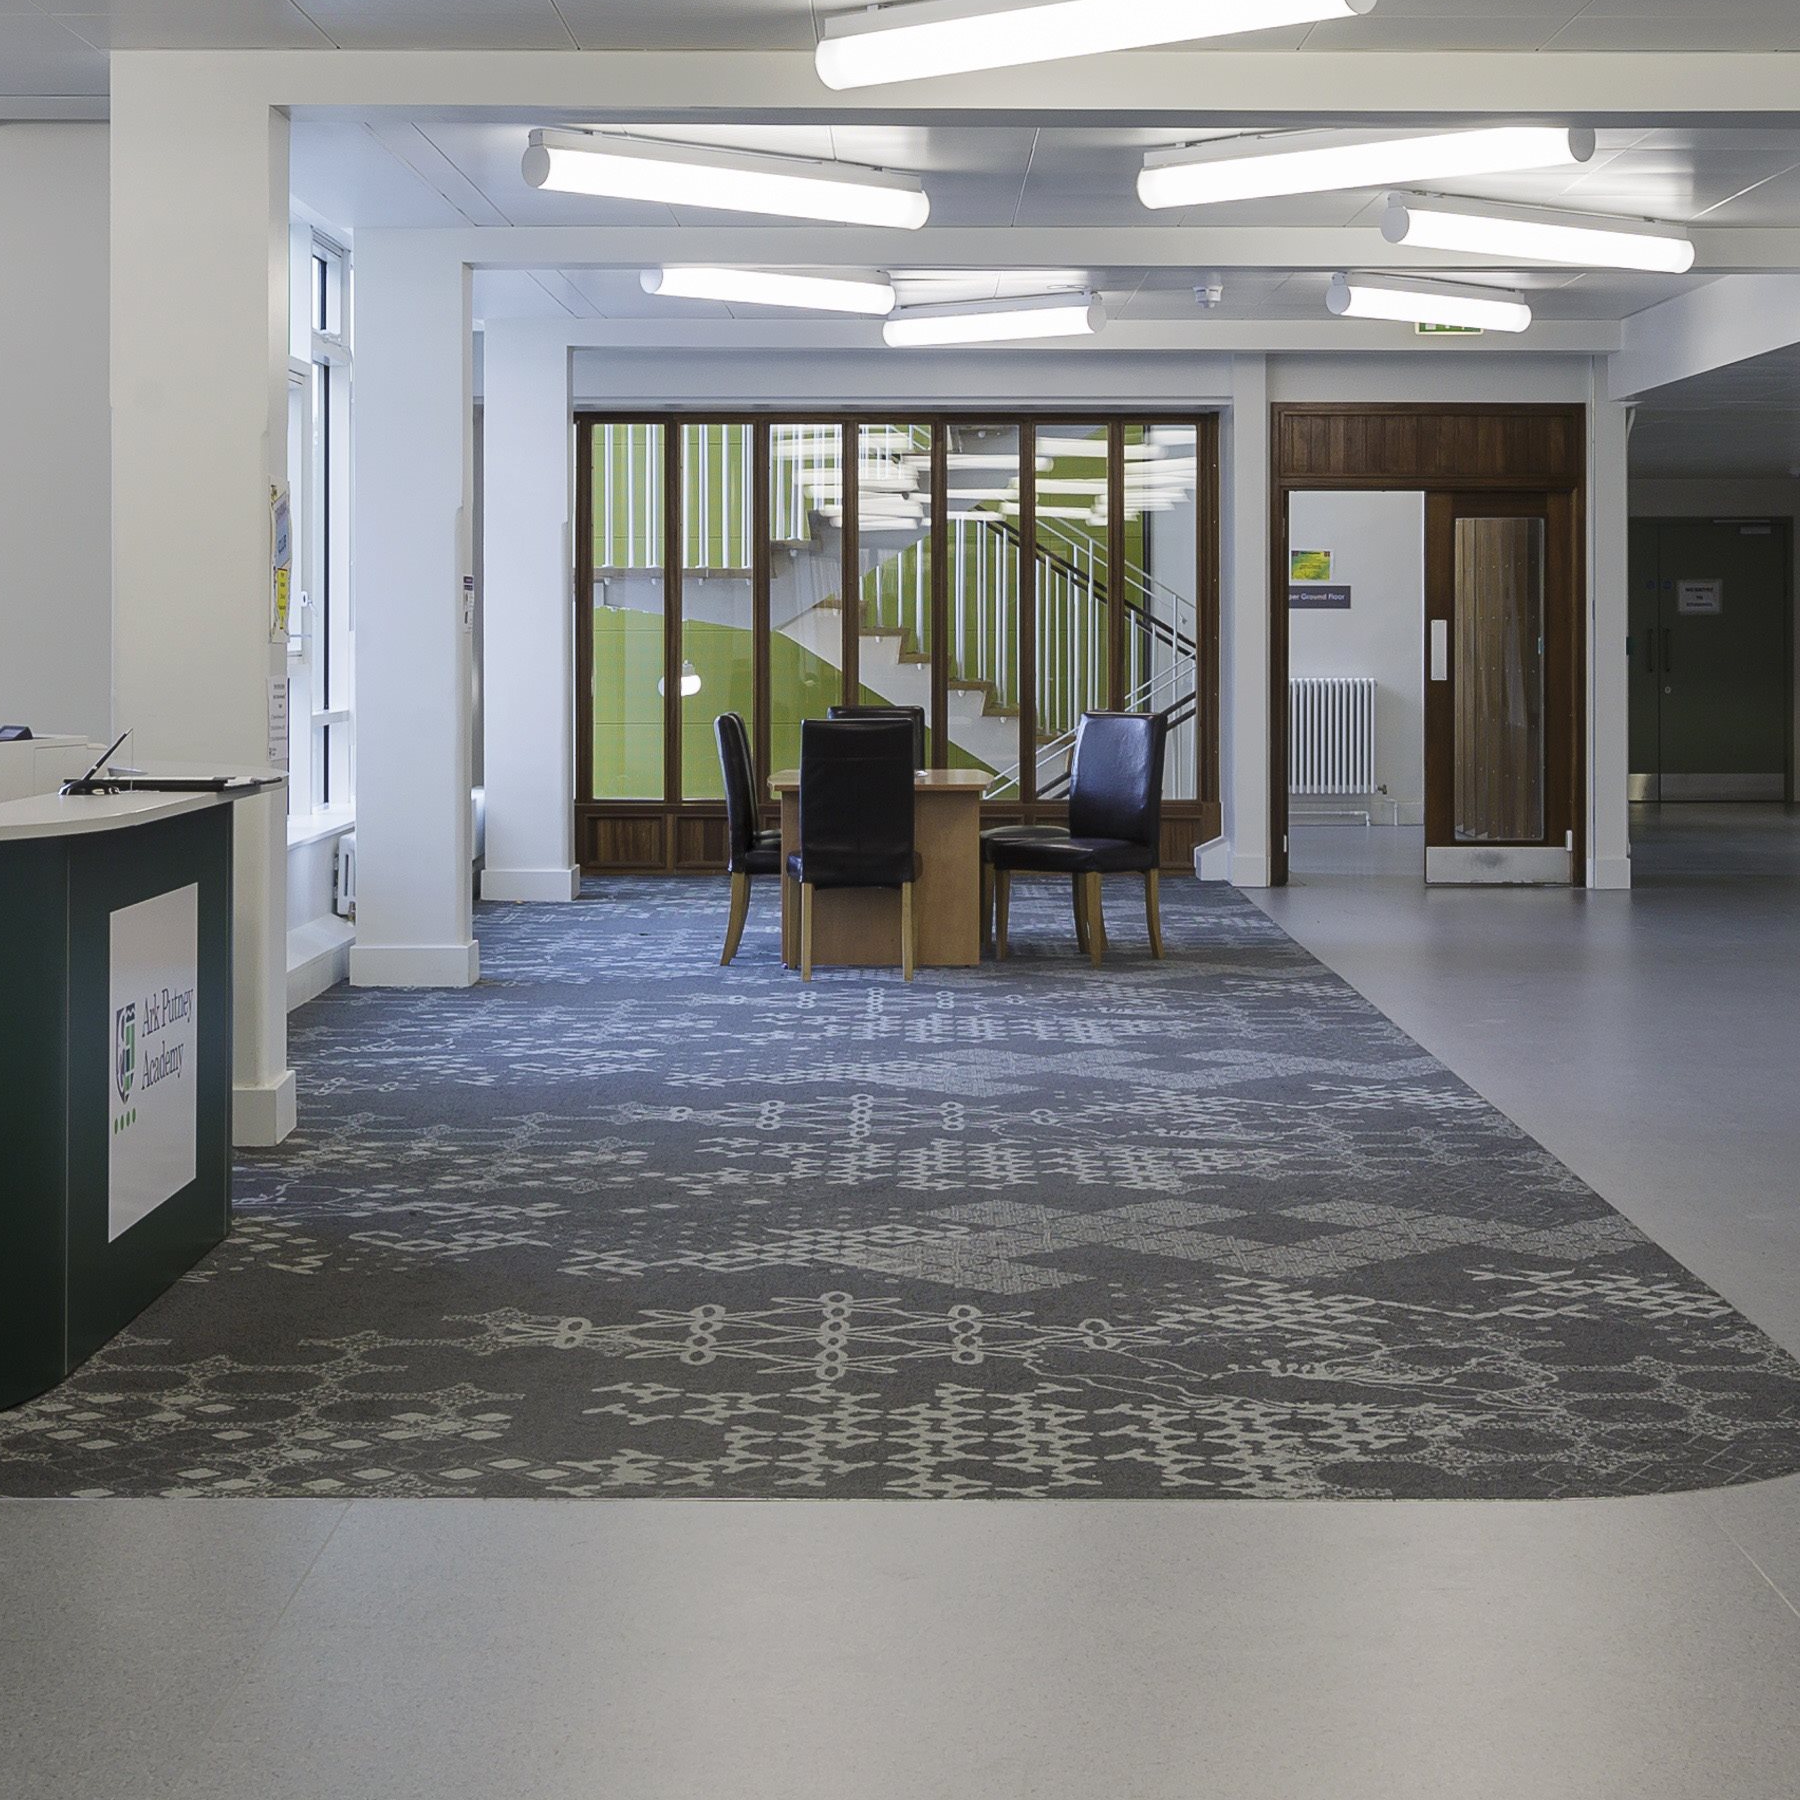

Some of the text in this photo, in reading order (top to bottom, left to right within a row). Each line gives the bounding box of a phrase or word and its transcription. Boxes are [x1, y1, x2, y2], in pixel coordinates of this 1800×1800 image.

[142, 988, 194, 1038] Ark Putney
[141, 1040, 184, 1091] Academy
